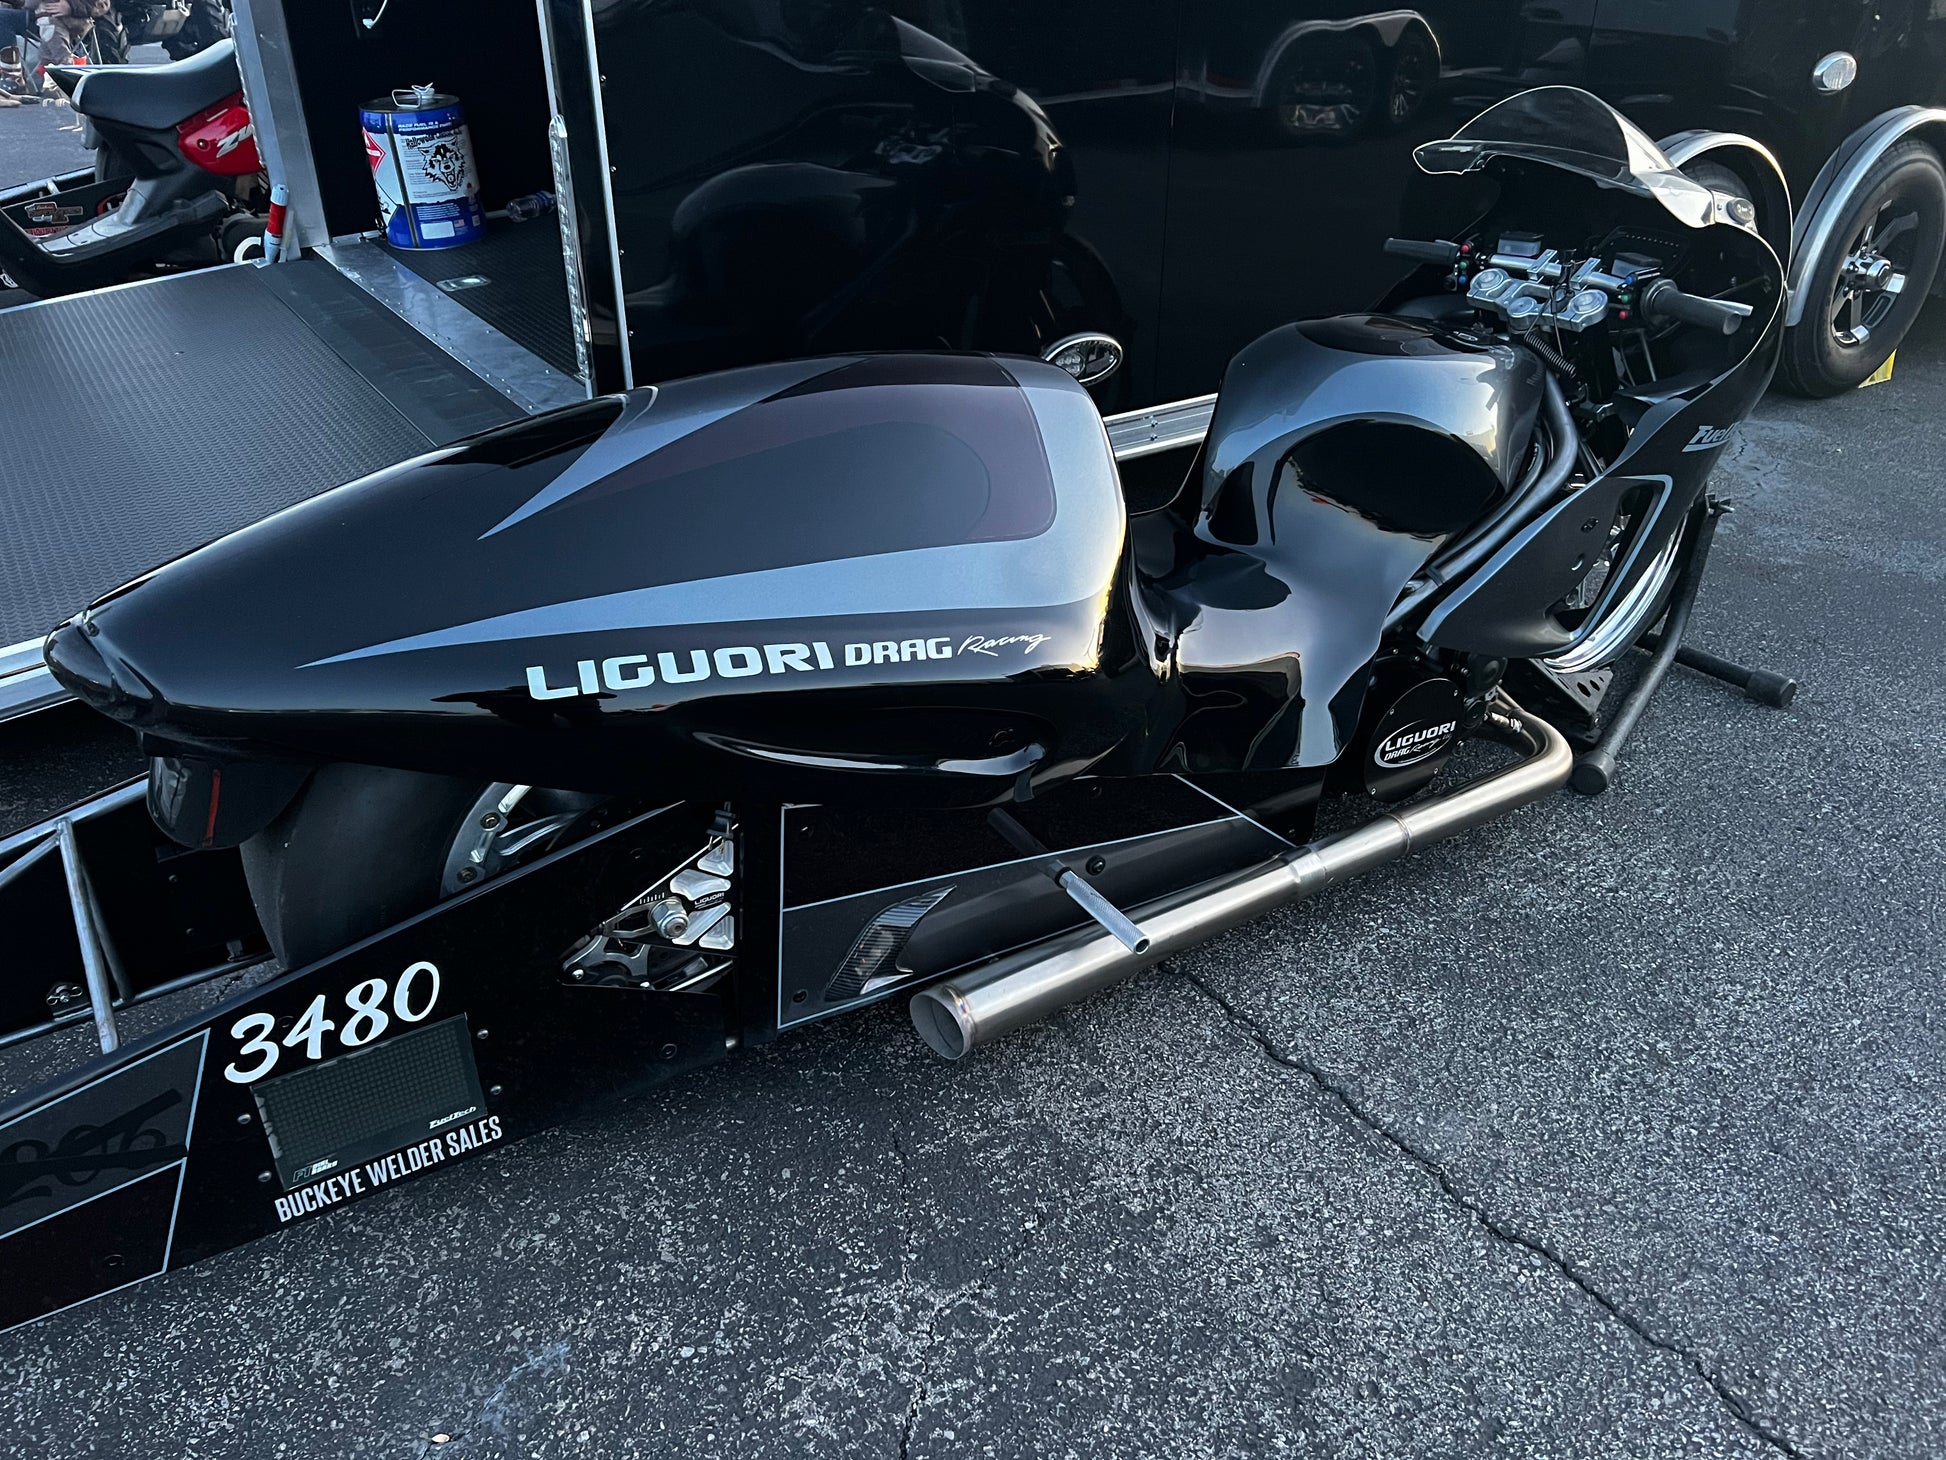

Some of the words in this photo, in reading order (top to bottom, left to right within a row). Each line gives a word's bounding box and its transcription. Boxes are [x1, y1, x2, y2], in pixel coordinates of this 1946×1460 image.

[216, 124, 254, 158] ZU
[526, 641, 834, 701] LIGUORI
[844, 636, 953, 667] DRAG
[957, 632, 1052, 656] Racing
[1385, 721, 1457, 752] LIGUORI
[1384, 746, 1411, 761] DRAG
[694, 892, 725, 905] LIGUORI
[224, 961, 441, 1084] 3480
[429, 1106, 477, 1130] FuelTech
[274, 1169, 366, 1223] BUCKEYE
[365, 1138, 444, 1187] WELDER
[447, 1115, 504, 1157] SALES
